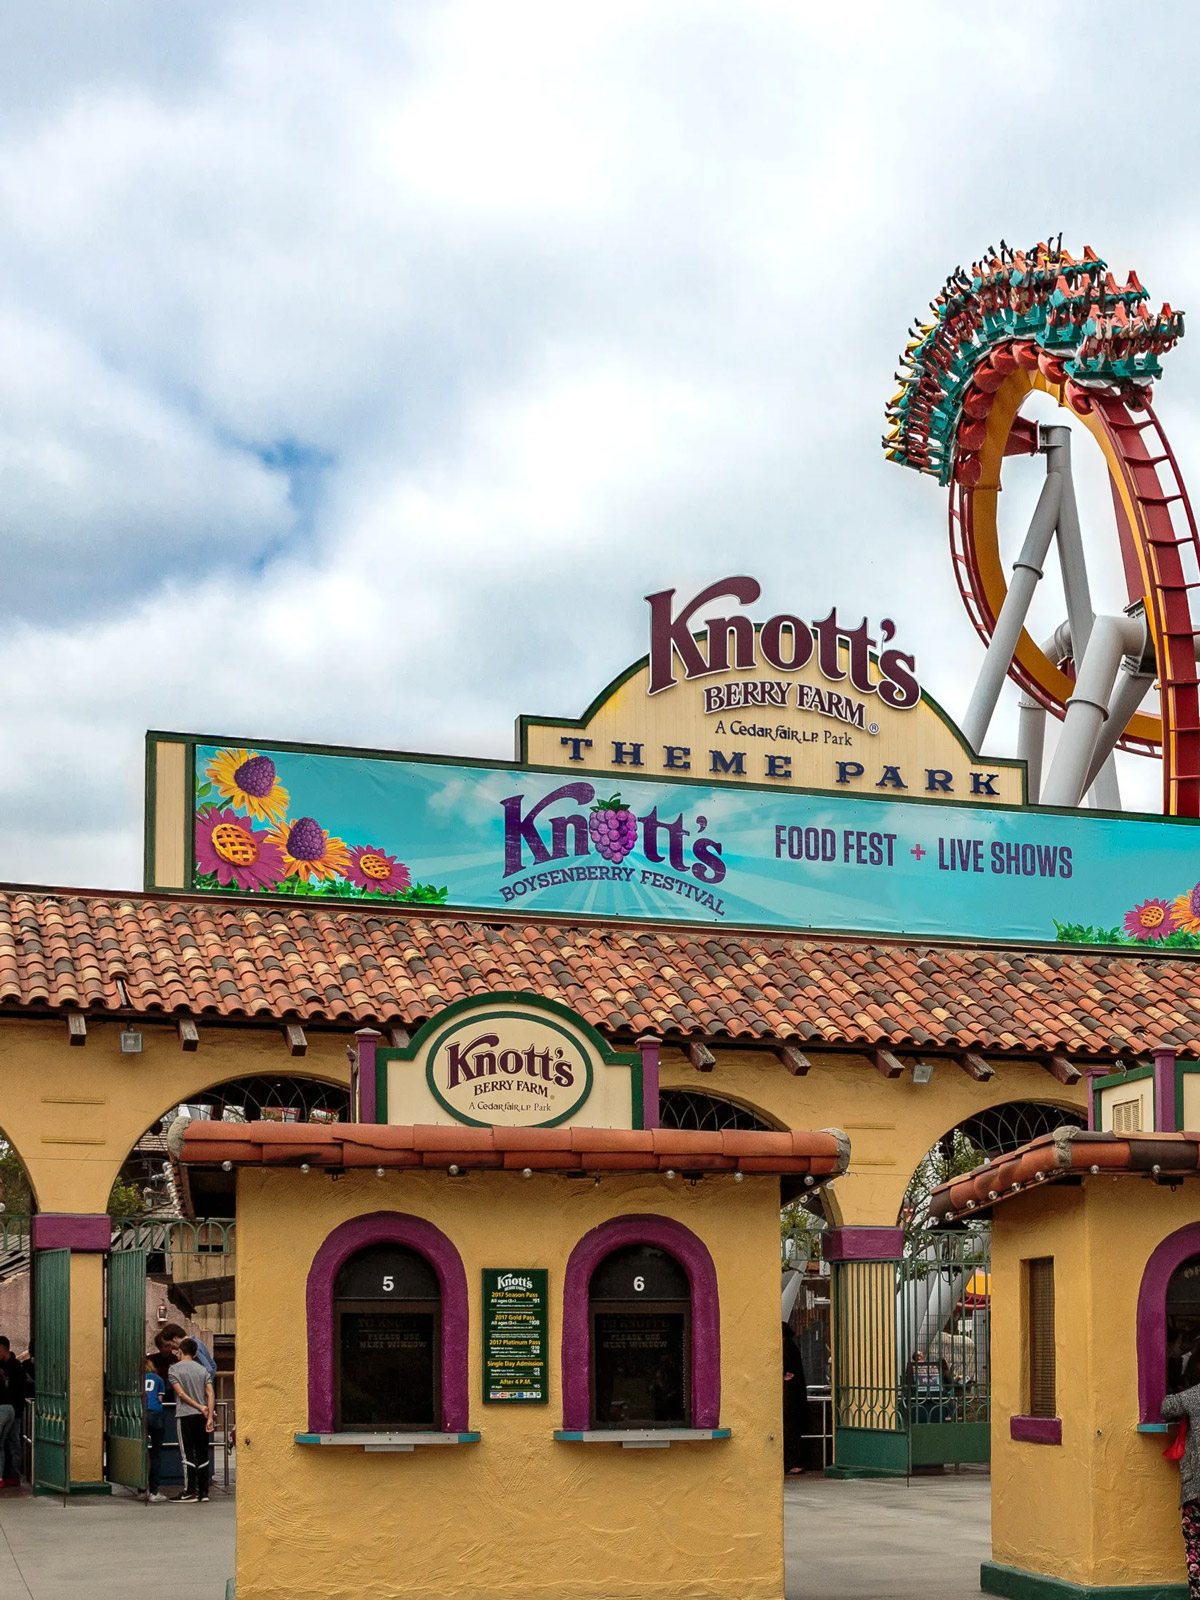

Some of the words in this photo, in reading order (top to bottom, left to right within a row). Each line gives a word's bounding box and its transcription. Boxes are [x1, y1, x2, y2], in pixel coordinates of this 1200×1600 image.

[644, 575, 921, 710] Knott's
[704, 680, 793, 714] BERRY
[796, 683, 866, 730] FARM
[715, 720, 726, 734] A
[824, 730, 852, 746] Park
[560, 736, 792, 778] THEME
[836, 760, 1000, 796] PARK
[775, 824, 836, 862] FOOD
[844, 830, 897, 866] FEST
[938, 838, 984, 872] LIVE
[990, 841, 1073, 879] SHOWS
[500, 866, 635, 902] BOYSENBERRY
[640, 870, 725, 916] FESTIVAL
[446, 1032, 574, 1089] Knott's
[468, 1102, 475, 1110] A
[534, 1102, 552, 1112] Park
[474, 1080, 514, 1096] BERRY
[516, 1080, 548, 1098] FARM
[382, 1276, 394, 1291] 5
[497, 1273, 533, 1290] Knott's
[633, 1276, 645, 1291] 6
